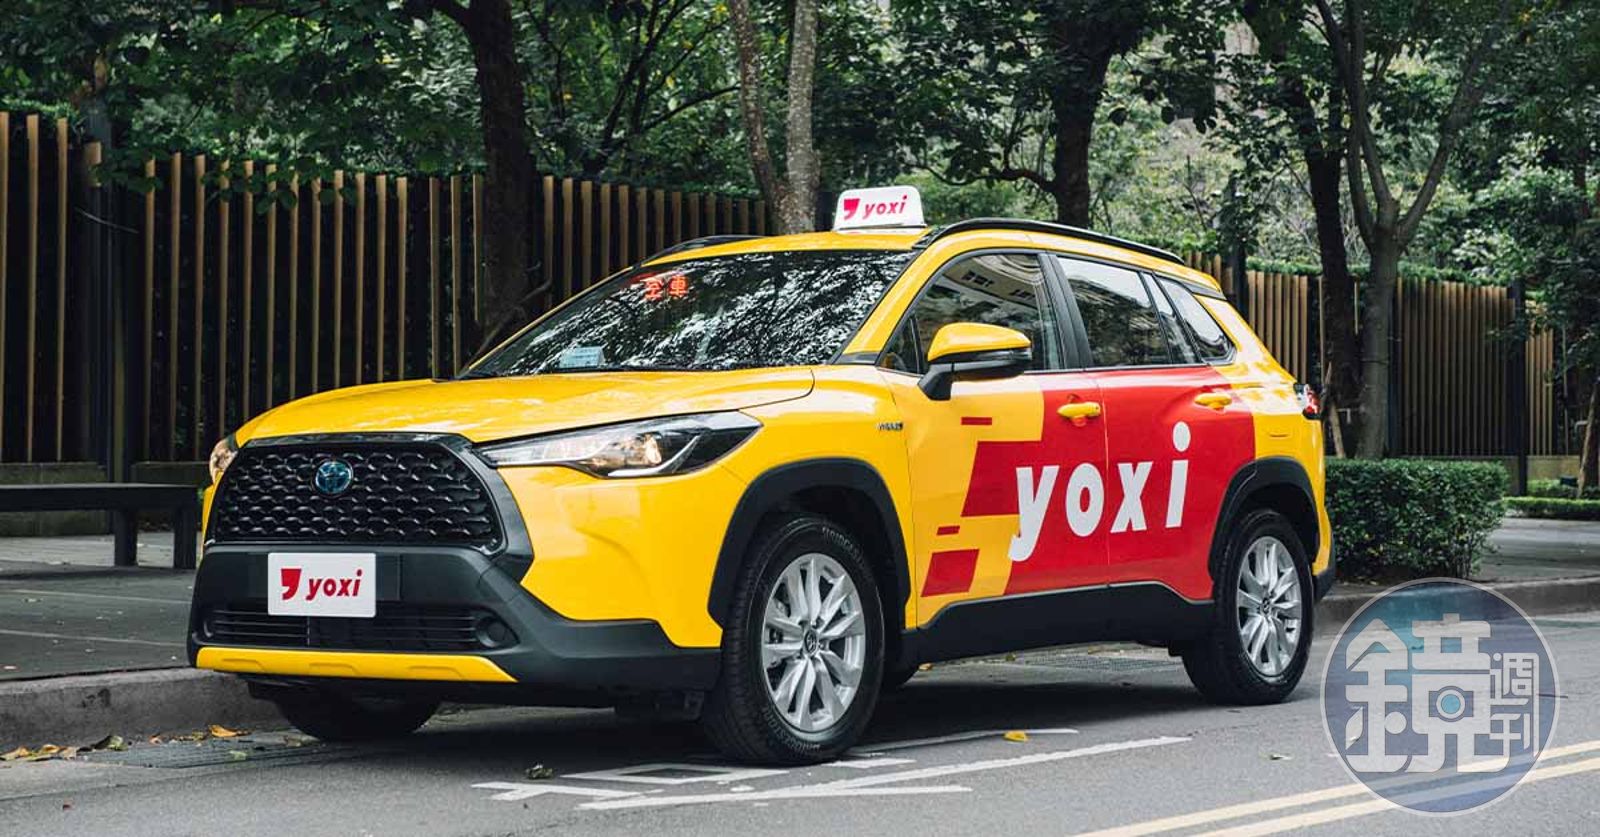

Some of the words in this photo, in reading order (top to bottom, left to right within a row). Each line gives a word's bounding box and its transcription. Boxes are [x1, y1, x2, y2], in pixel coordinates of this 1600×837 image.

[863, 195, 908, 219] yoxi
[1008, 421, 1191, 562] yoxi
[305, 569, 362, 601] yoxi
